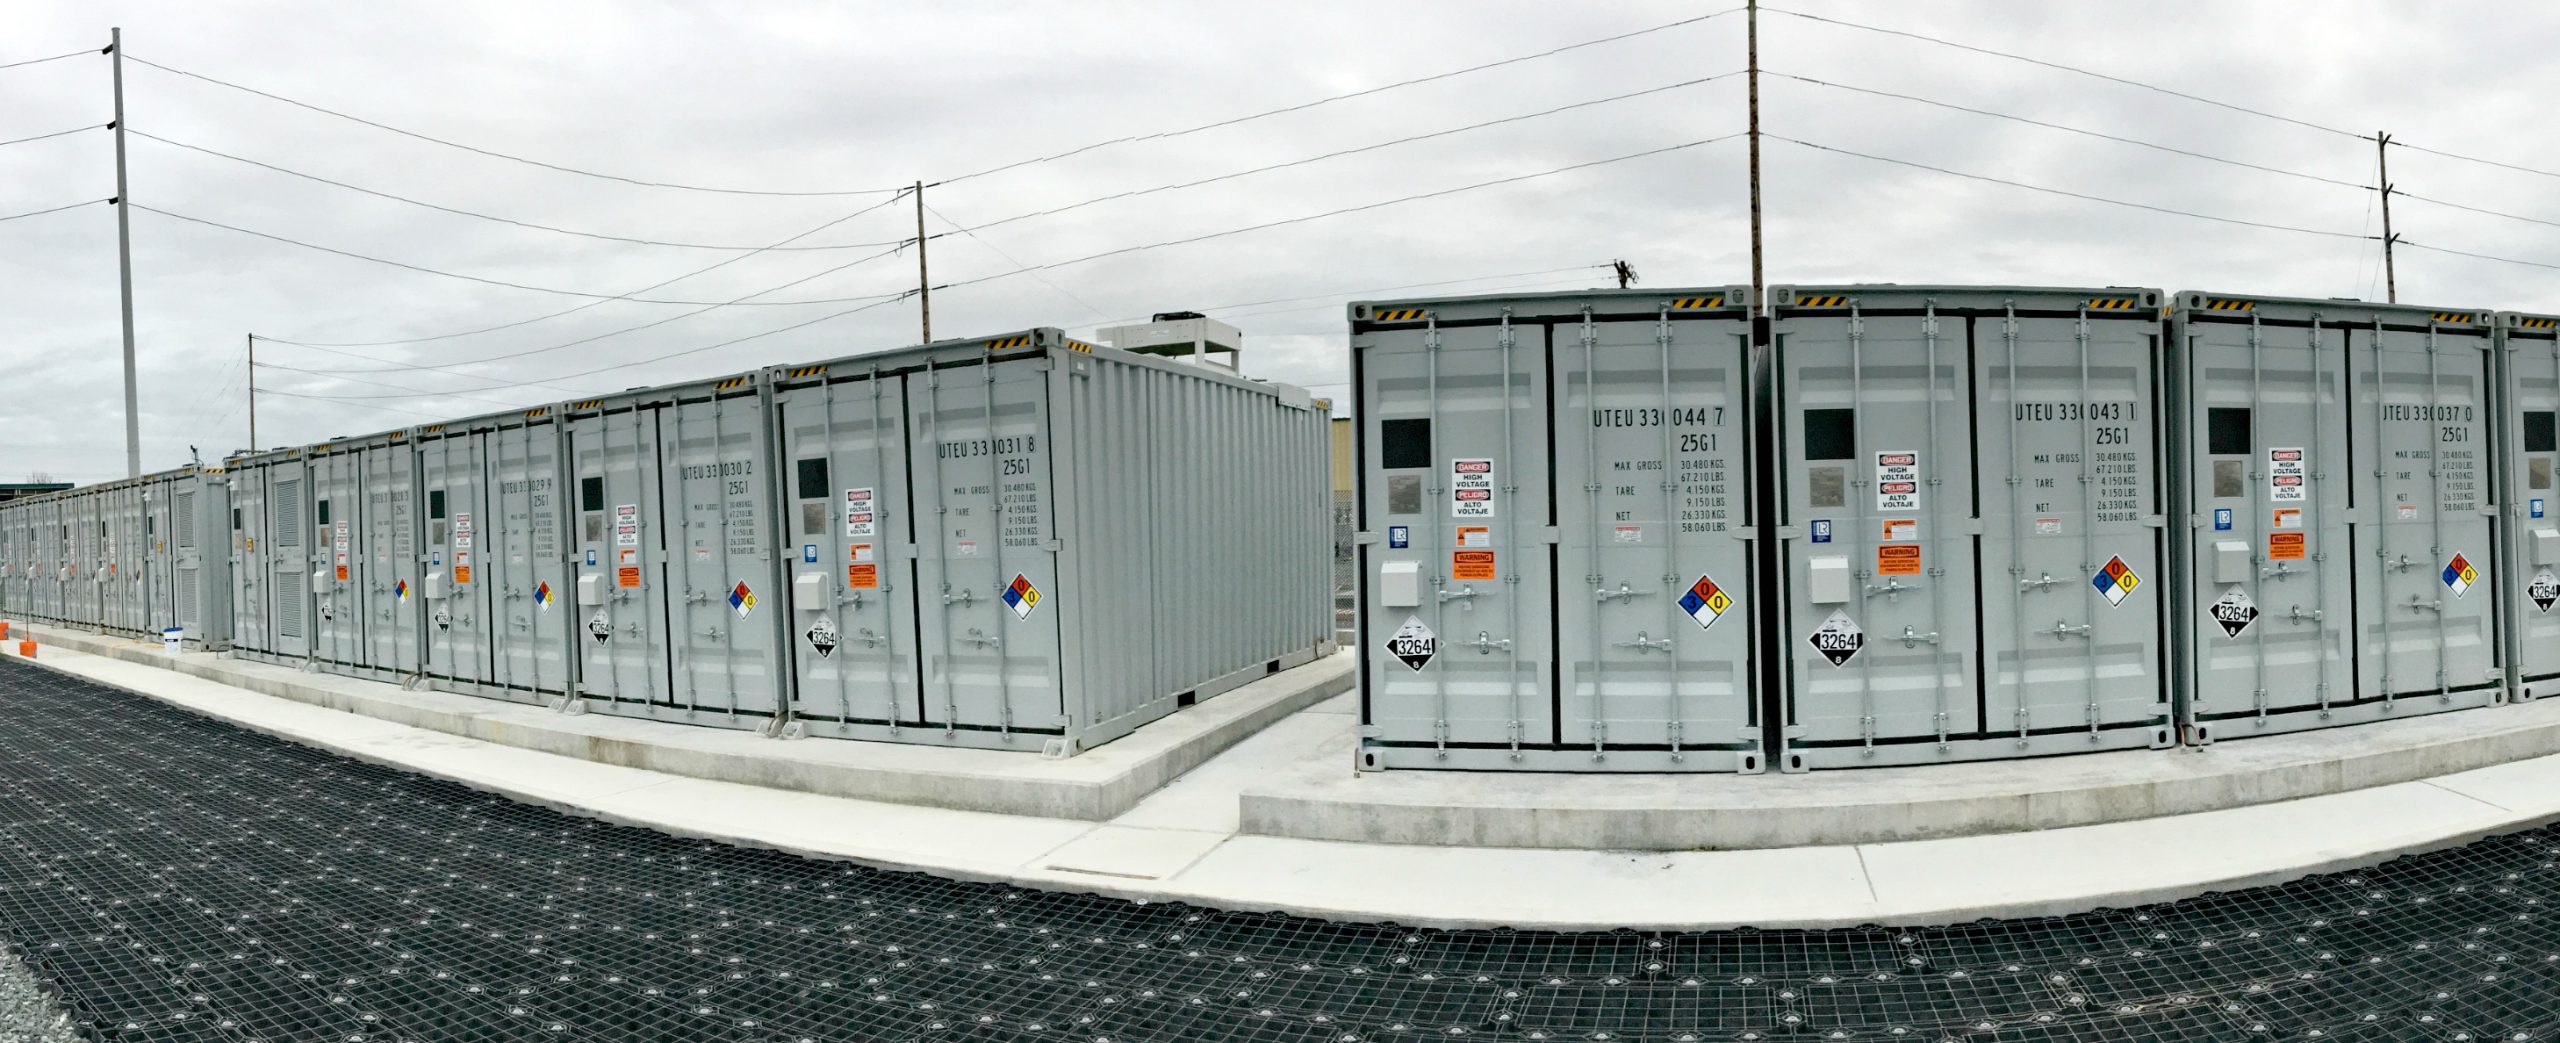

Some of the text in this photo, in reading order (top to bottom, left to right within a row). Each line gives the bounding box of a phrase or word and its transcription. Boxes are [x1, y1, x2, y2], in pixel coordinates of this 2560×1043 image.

[1593, 409, 1633, 427] UTEU
[1715, 407, 1723, 425] 7
[2015, 403, 2052, 421] UTEU
[2465, 406, 2472, 422] 0
[2096, 427, 2129, 445] 25G1
[2442, 426, 2468, 442] 25G1
[939, 442, 967, 459] UTEU
[1028, 436, 1035, 452] 8
[1681, 433, 1716, 452] 25G1
[2034, 453, 2080, 464] MAX GROSS
[746, 461, 752, 475] 2
[1003, 458, 1030, 475] 25G1
[1614, 460, 1662, 471] MAX GROSS
[729, 480, 749, 495] 25G1
[2035, 478, 2054, 488] TARE
[1615, 486, 1635, 496] TARE
[2036, 503, 2050, 512] NET
[1616, 511, 1631, 521] NET
[2112, 562, 2120, 575] 0
[2456, 559, 2462, 570] 0
[2465, 569, 2471, 580] 0
[1018, 580, 1024, 591] 0
[2100, 575, 2132, 588] 3 0
[1701, 582, 1710, 596] 0
[2533, 585, 2556, 598] 3264
[1028, 591, 1035, 602] 0
[1687, 595, 1723, 609] 3 0
[2219, 605, 2249, 621] 3264
[2230, 626, 2236, 635] 8
[813, 631, 835, 644] 3264
[1821, 633, 1856, 649] 3264
[1398, 639, 1431, 655] 3264
[1413, 660, 1420, 669] 8
[1835, 656, 1842, 664] 8
